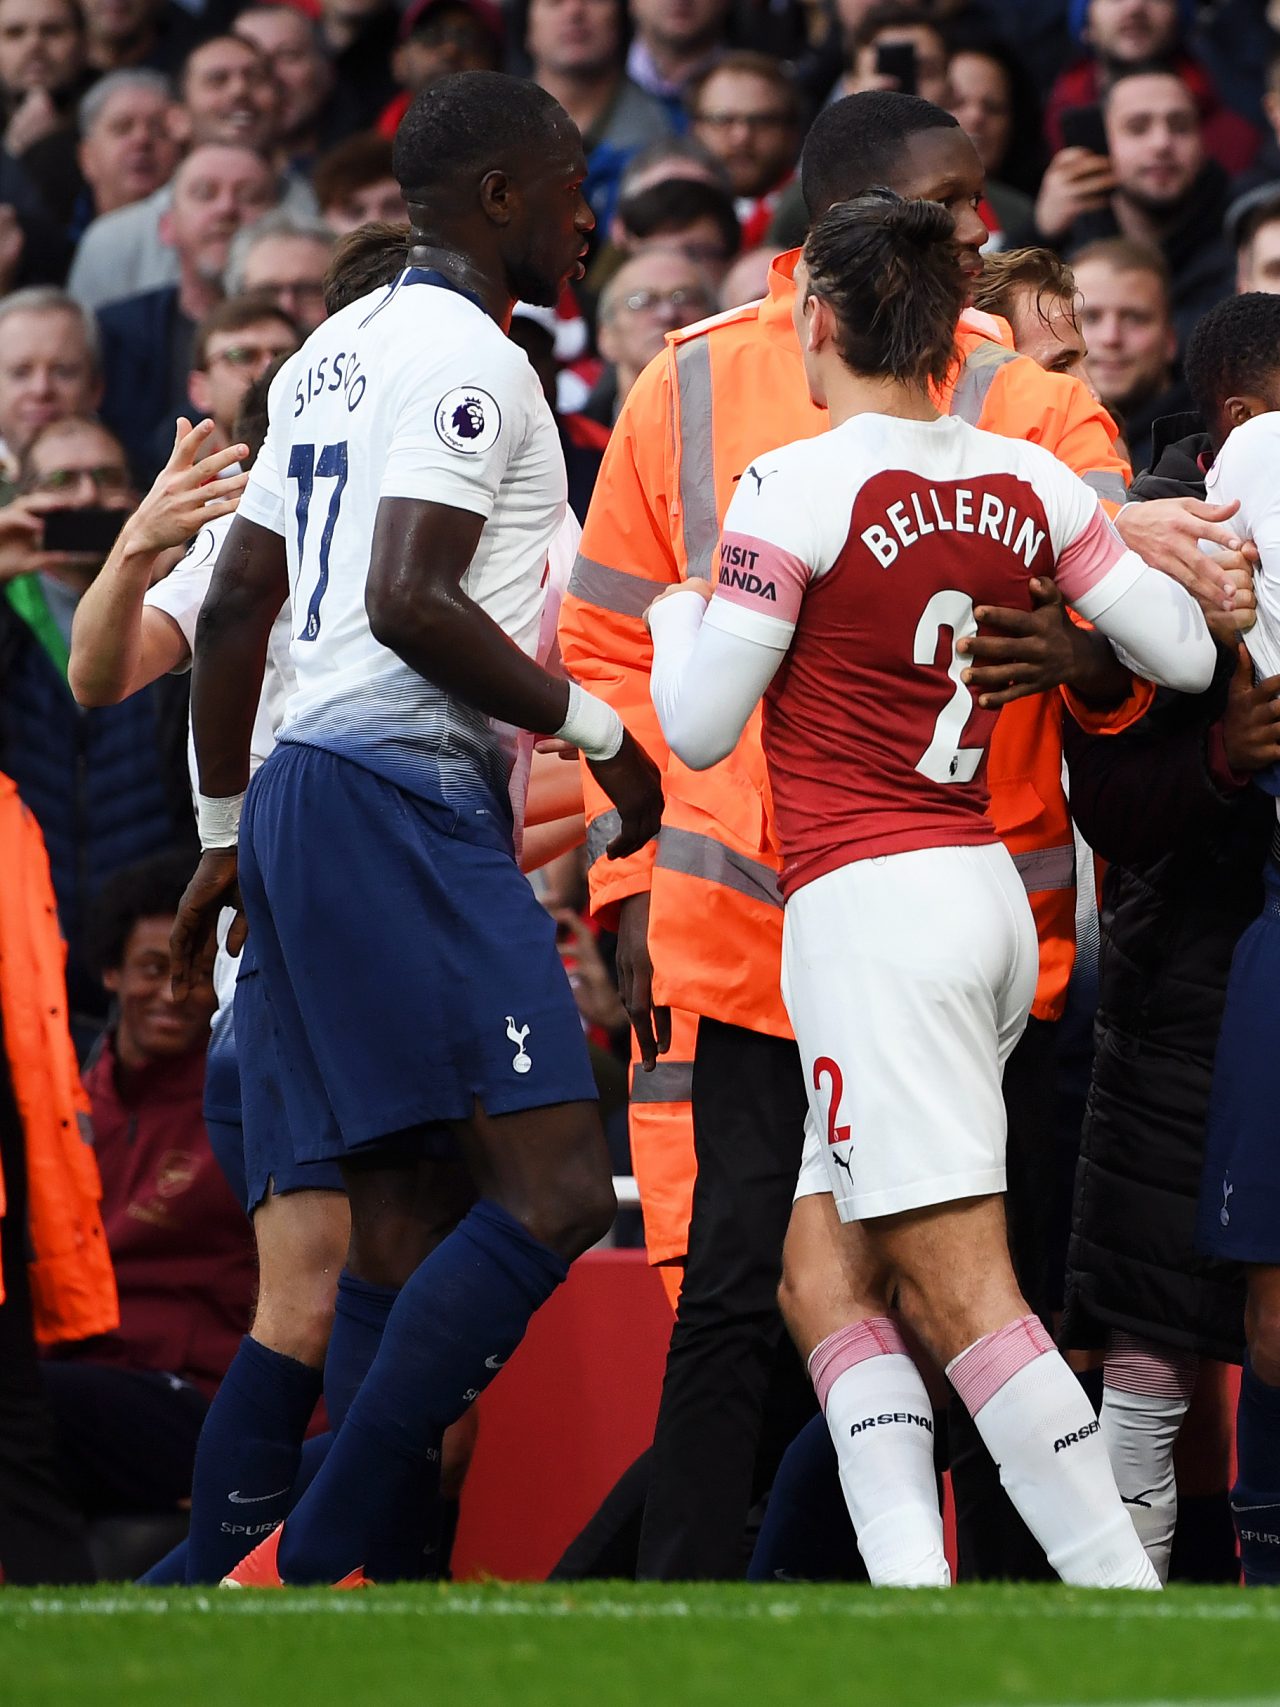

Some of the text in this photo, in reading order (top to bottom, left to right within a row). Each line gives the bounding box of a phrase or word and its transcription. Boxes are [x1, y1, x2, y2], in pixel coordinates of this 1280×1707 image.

[287, 440, 348, 641] 17
[720, 542, 760, 570] VISIT
[861, 488, 1046, 569] BELLERIN
[913, 589, 984, 784] 2
[813, 1056, 851, 1145] 2
[850, 1412, 933, 1437] ARSENAL
